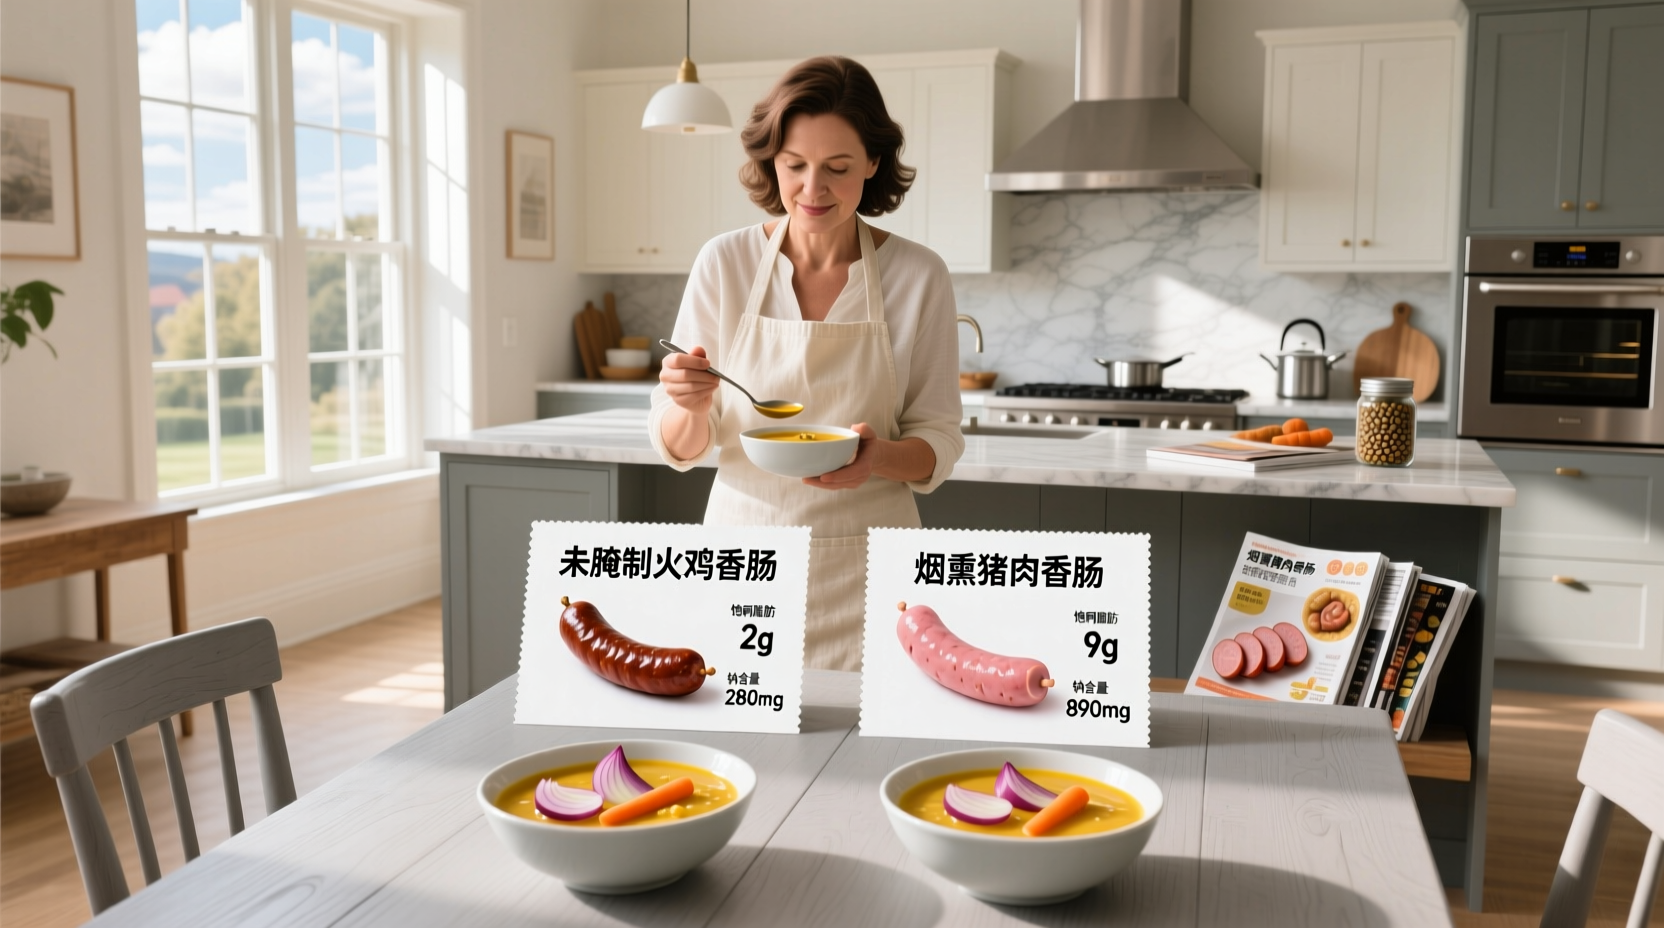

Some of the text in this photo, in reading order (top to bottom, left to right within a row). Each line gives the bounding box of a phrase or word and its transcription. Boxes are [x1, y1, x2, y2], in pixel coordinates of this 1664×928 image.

[559, 545, 777, 582] 未腌制火鸡香肠
[914, 551, 1104, 589] 烟熏猪肉香肠
[739, 623, 774, 657] 2g
[1083, 630, 1119, 665] 9g
[725, 688, 784, 712] 280mg
[1066, 698, 1131, 724] 890mg
